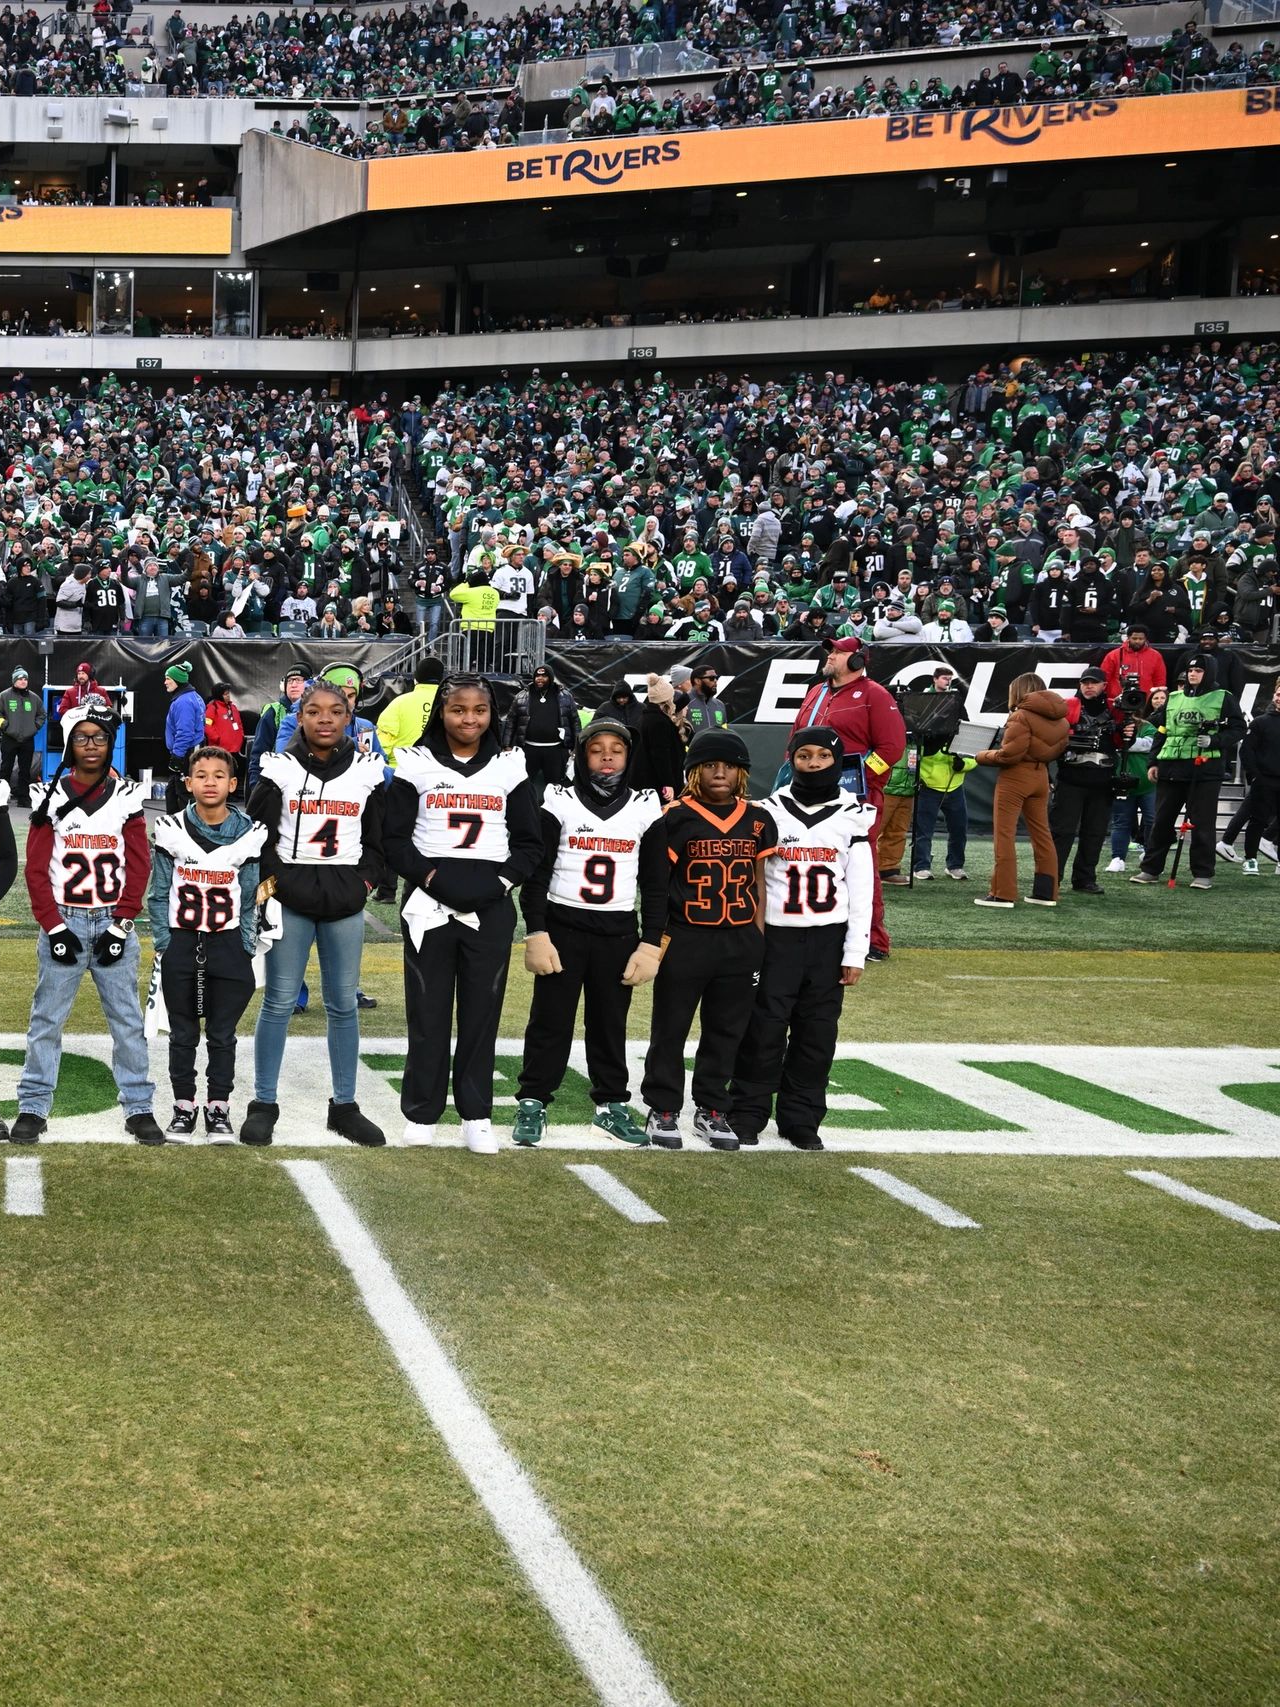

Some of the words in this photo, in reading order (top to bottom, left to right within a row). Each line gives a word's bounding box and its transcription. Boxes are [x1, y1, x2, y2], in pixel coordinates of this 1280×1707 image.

[763, 75, 776, 86] 62
[506, 139, 681, 186] BETRIVERS
[1198, 322, 1225, 333] 135
[630, 348, 654, 358] 136
[139, 359, 159, 368] 137
[922, 389, 937, 400] 26
[430, 455, 443, 467] 12
[304, 562, 316, 579] 11
[677, 560, 697, 577] 88
[865, 554, 885, 571] 20
[509, 577, 526, 593] 33
[618, 576, 629, 593] 2
[96, 589, 117, 607] 36
[1048, 591, 1058, 608] 1
[1084, 590, 1098, 608] 6
[1178, 711, 1198, 721] FOX
[289, 799, 361, 817] PANTHERS
[426, 793, 503, 811] PANTHERS
[307, 818, 339, 858] 4
[447, 811, 484, 849] 7
[568, 836, 637, 853] PANTHERS
[687, 839, 757, 858] CHESTER
[777, 847, 839, 863] PANTHERS
[61, 851, 121, 906] 20
[177, 865, 235, 885] PANTHERS
[579, 854, 616, 905] 9
[685, 859, 757, 926] 33
[783, 864, 838, 915] 10
[176, 883, 234, 932] 88
[197, 969, 205, 1015] lululemon
